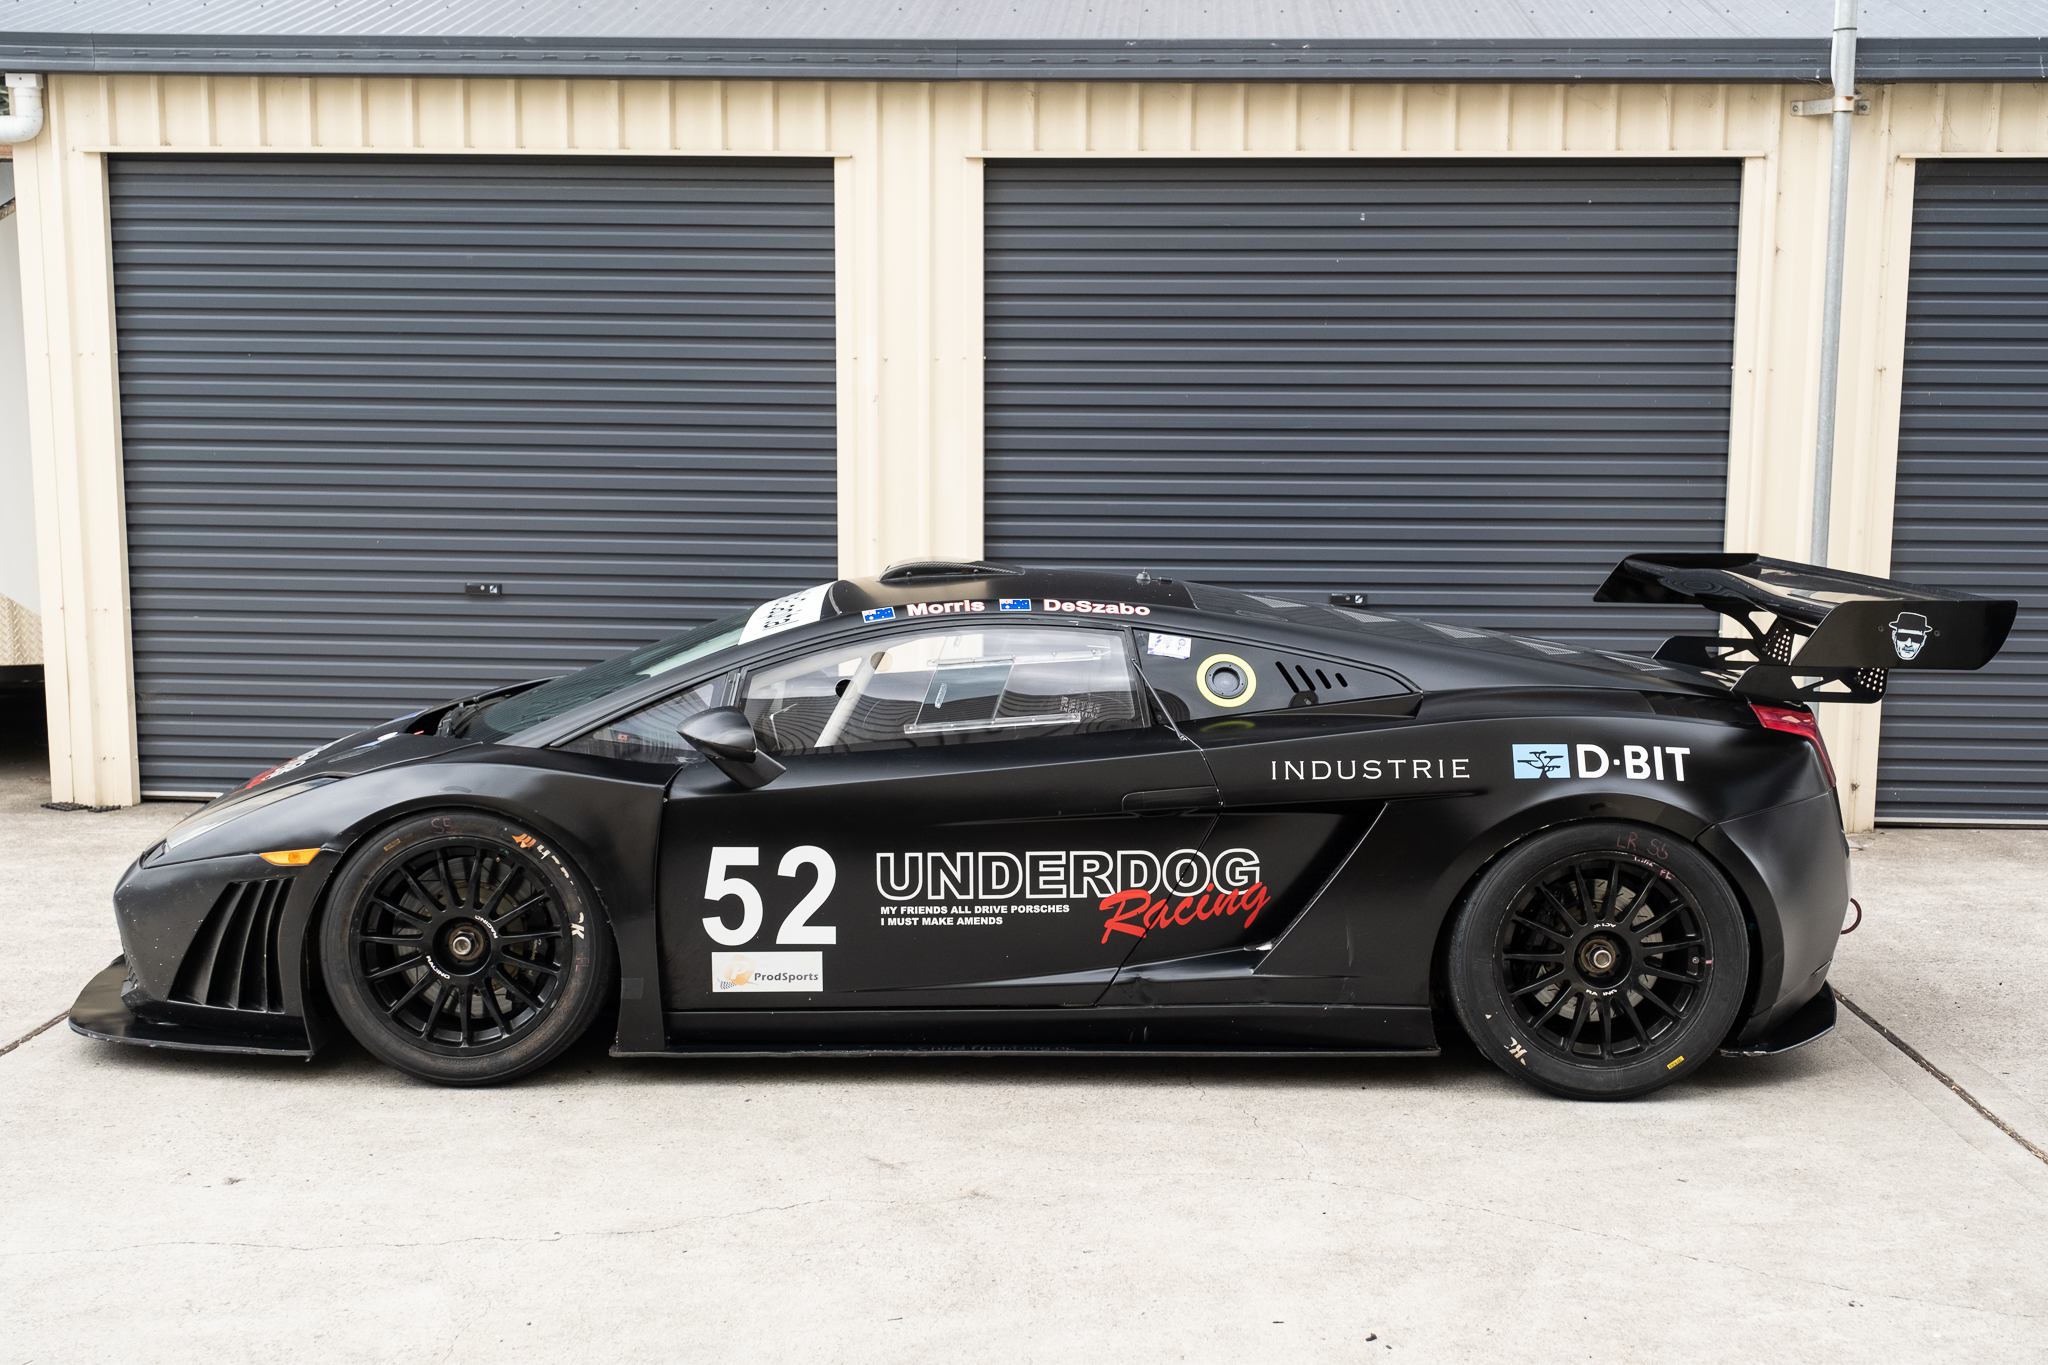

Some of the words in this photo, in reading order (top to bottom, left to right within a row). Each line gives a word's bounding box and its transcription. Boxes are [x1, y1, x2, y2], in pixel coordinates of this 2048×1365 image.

[906, 599, 986, 617] Morris
[1043, 598, 1151, 617] DeSzabo
[1271, 758, 1471, 781] INDUSTRIE
[876, 848, 1261, 901] UNDERDOG
[701, 845, 838, 946] 52
[880, 906, 898, 915] MY
[900, 905, 947, 915] FRIENDS
[950, 905, 972, 915] ALL
[974, 905, 1008, 915] DRIVE
[1010, 904, 1070, 914] PORSCHES
[1099, 881, 1271, 945] Racing
[880, 917, 885, 926] I
[887, 917, 920, 926] MUST
[921, 917, 954, 926] MAKE
[956, 917, 1004, 926] AMENDS
[754, 972, 819, 983] ProdSports
